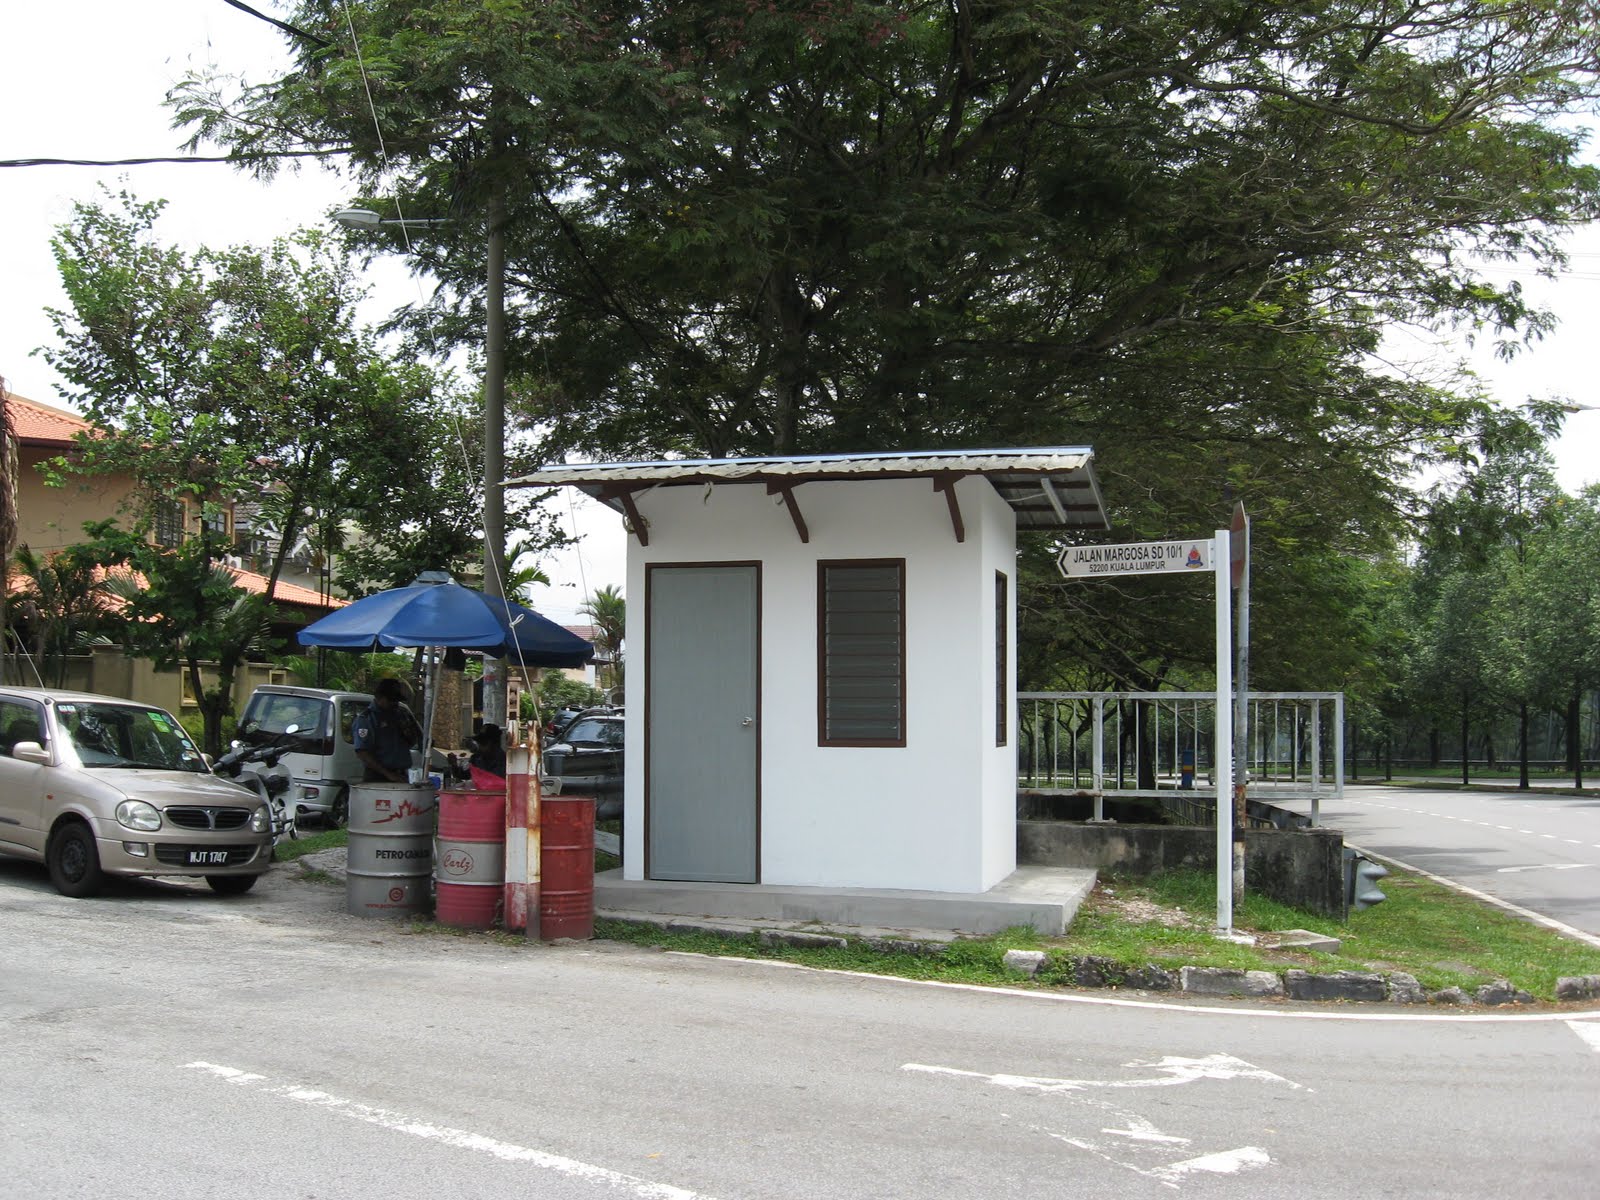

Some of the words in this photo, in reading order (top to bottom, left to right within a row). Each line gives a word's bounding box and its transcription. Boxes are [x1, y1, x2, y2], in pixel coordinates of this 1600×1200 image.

[1074, 549, 1102, 563] JALAN
[1104, 547, 1150, 562] MARGOSA
[1151, 546, 1164, 560] SD
[1166, 545, 1183, 559] 10/1
[1089, 563, 1109, 573] 52200
[1110, 562, 1134, 572] KUALA
[1136, 560, 1166, 571] LUMPUR
[210, 851, 228, 863] 1747
